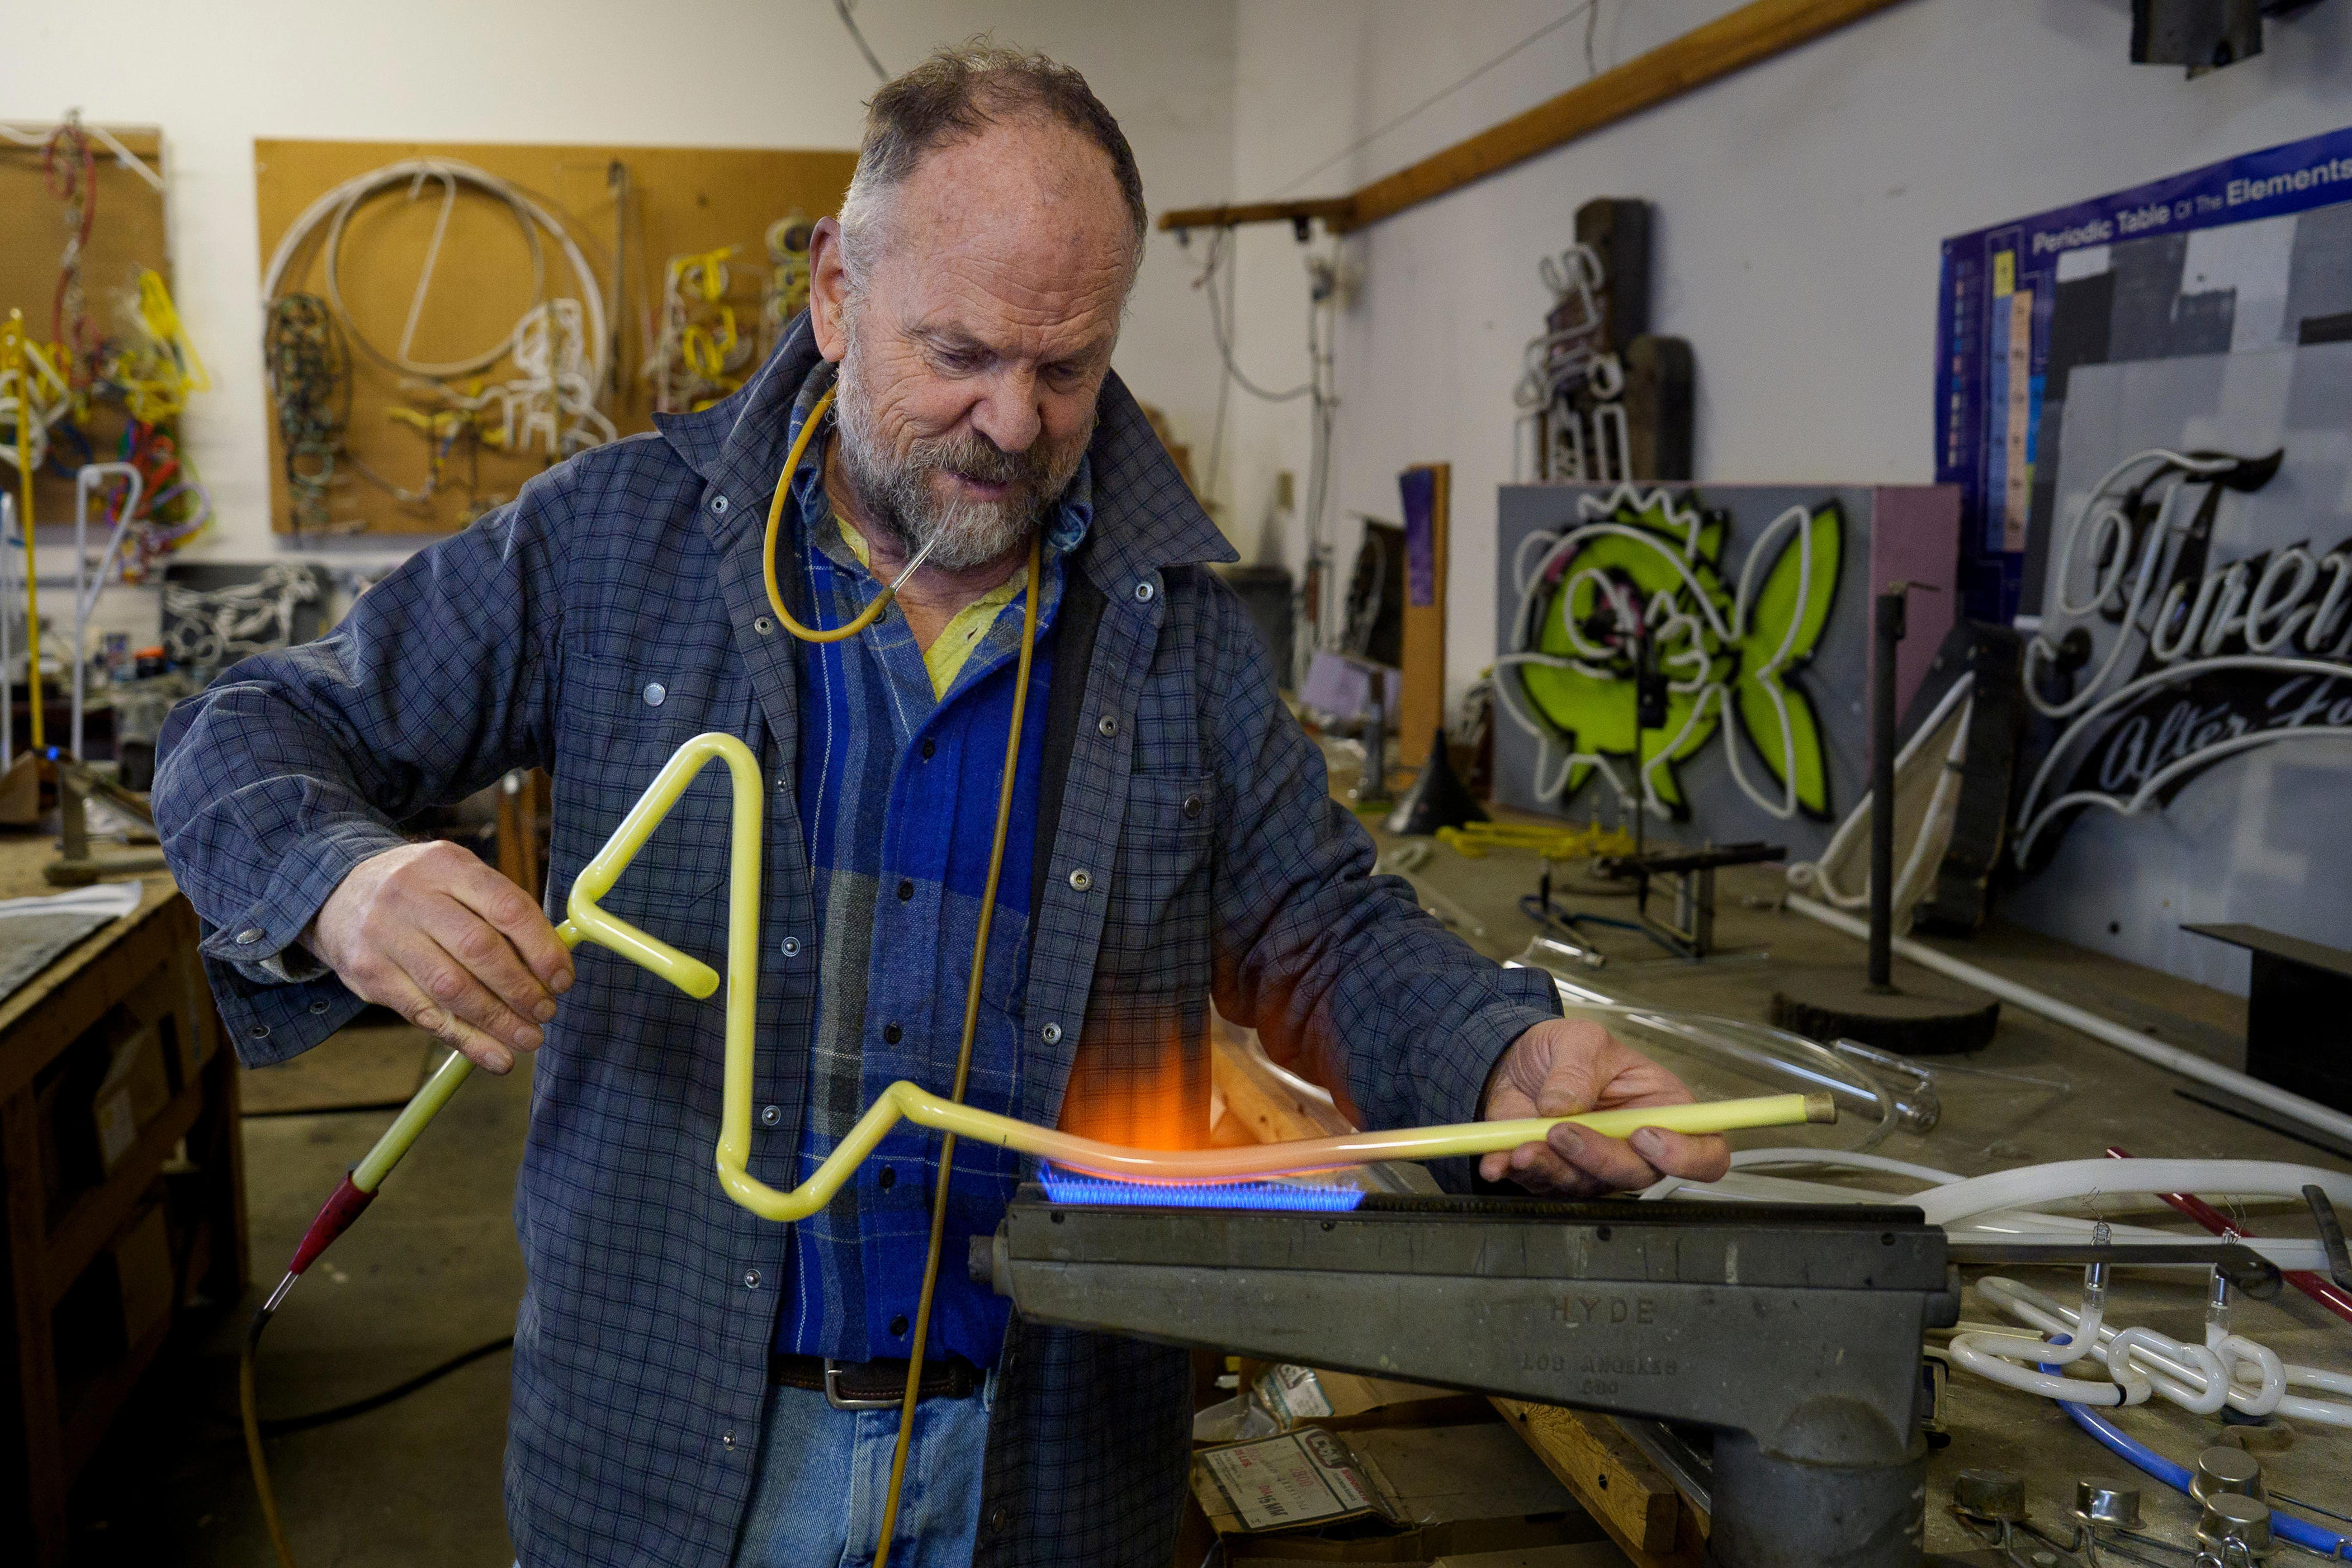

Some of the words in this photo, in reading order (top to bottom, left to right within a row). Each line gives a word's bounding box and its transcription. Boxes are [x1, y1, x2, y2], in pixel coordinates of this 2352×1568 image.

[2033, 219, 2114, 256] Periodic
[2116, 203, 2171, 235] Table
[2226, 157, 2352, 207] Elements
[1550, 1295, 1654, 1324] HYDE
